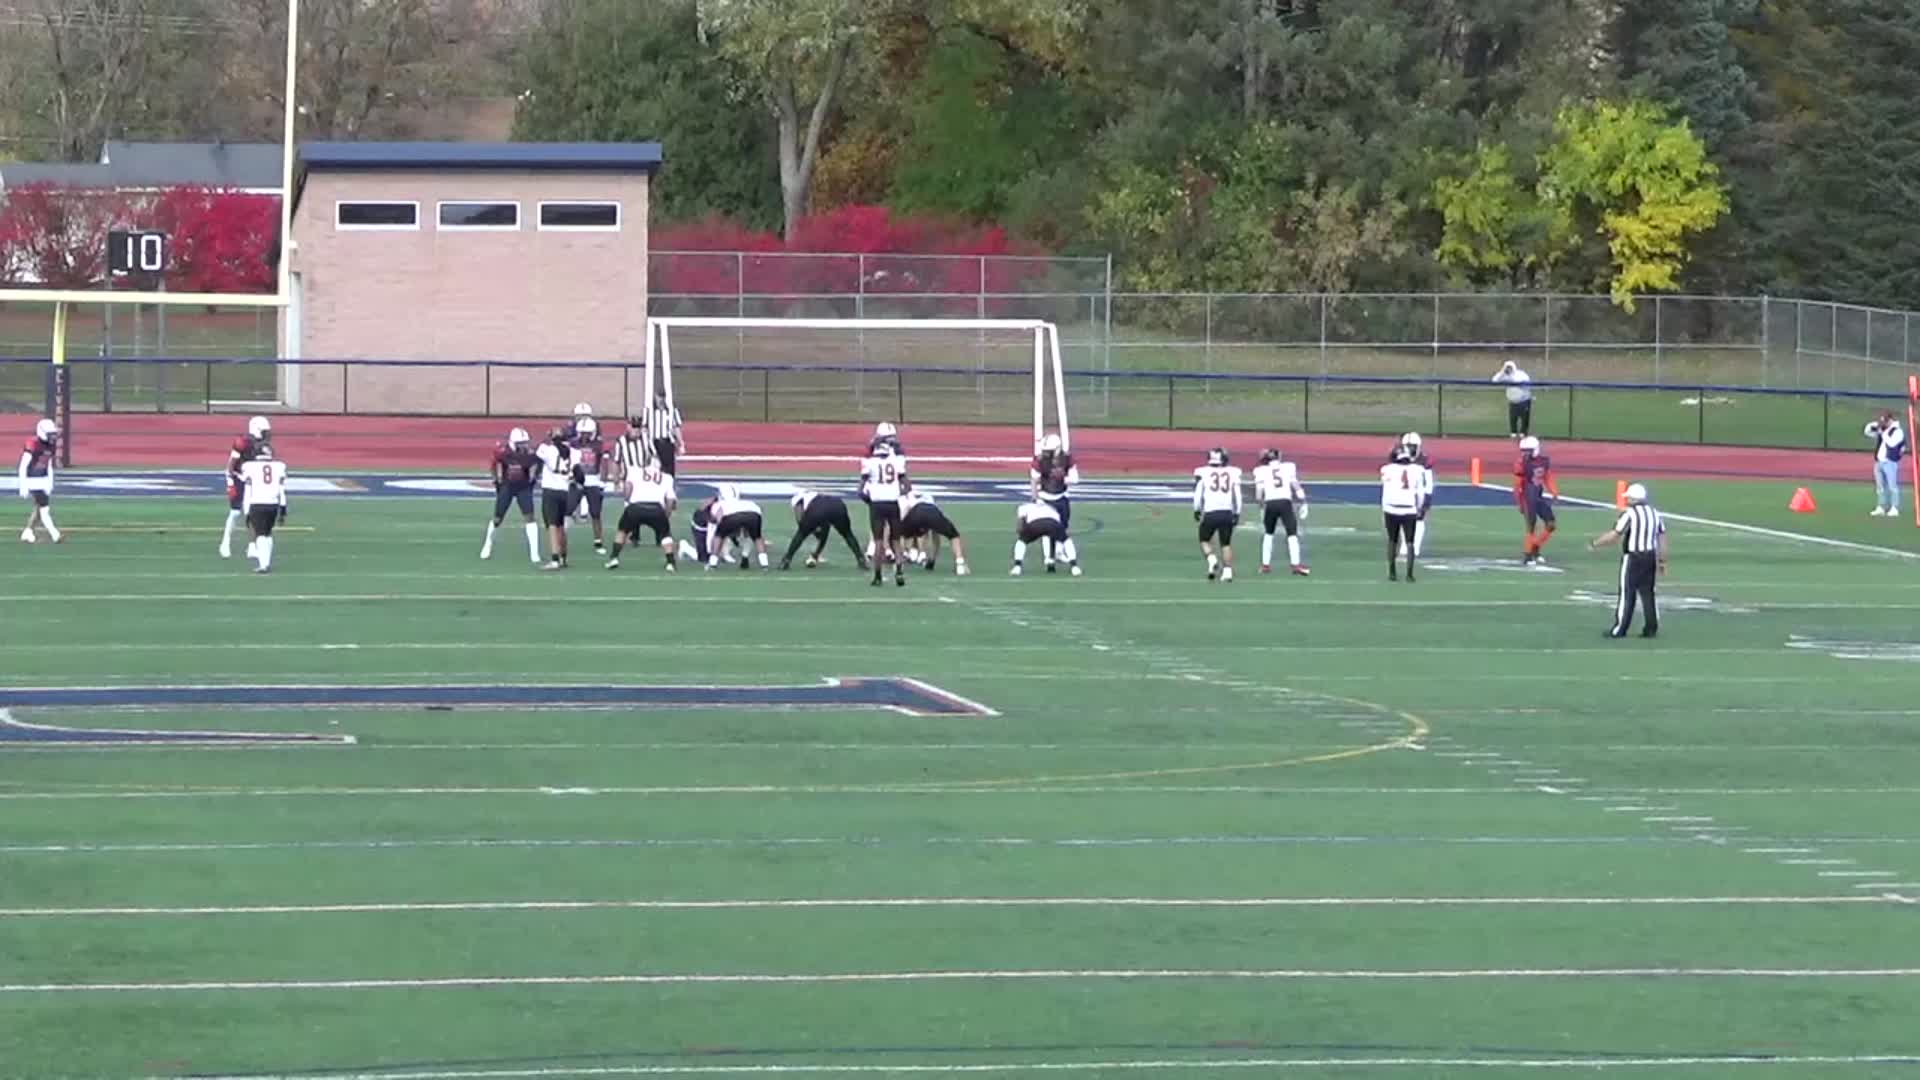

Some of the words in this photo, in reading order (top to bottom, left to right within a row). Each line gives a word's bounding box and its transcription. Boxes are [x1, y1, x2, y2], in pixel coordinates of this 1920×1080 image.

[127, 235, 162, 270] 10
[262, 464, 273, 485] 8
[878, 463, 895, 484] 19
[1209, 471, 1231, 494] 33
[1272, 468, 1283, 488] 5
